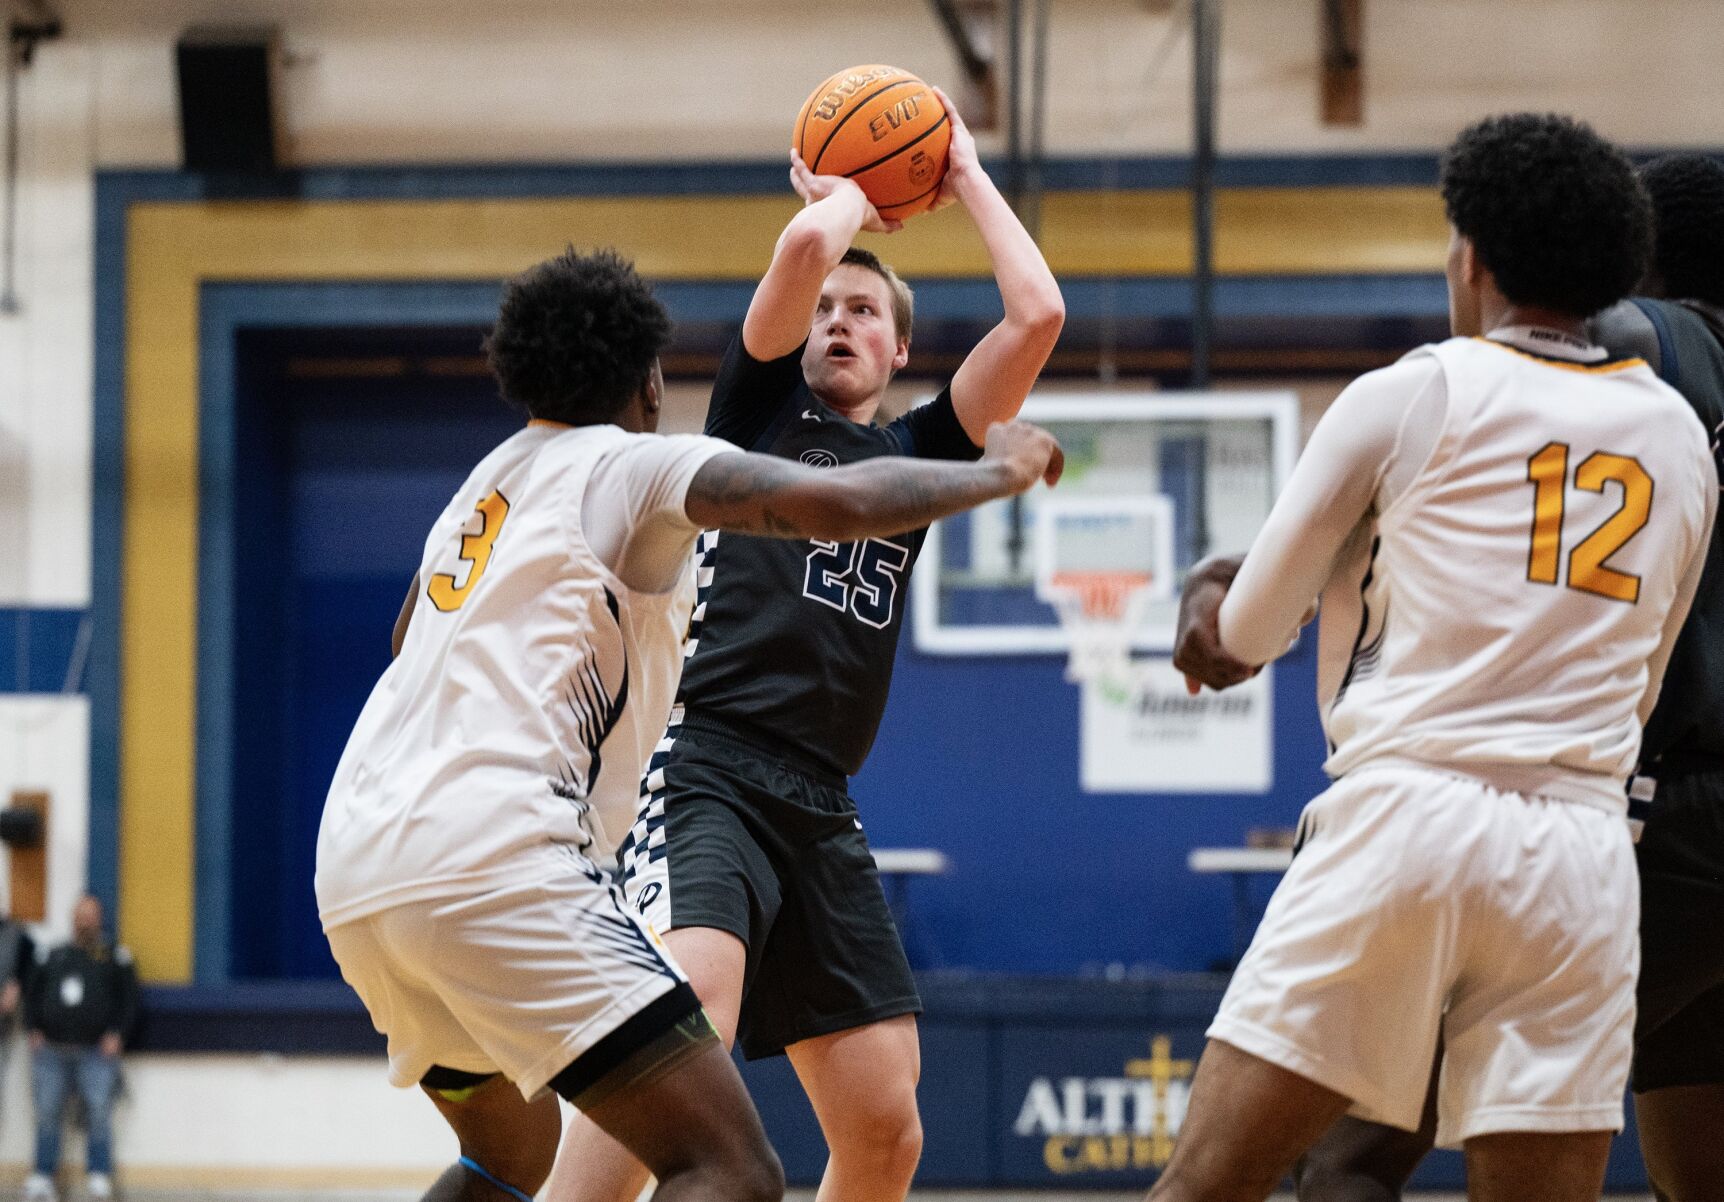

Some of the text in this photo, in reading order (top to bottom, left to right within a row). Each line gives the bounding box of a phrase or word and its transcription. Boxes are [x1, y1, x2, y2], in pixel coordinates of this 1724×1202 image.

[427, 488, 511, 613] 3
[1526, 440, 1655, 606] 12
[802, 536, 909, 630] 25
[1013, 1075, 1190, 1137] ALTH
